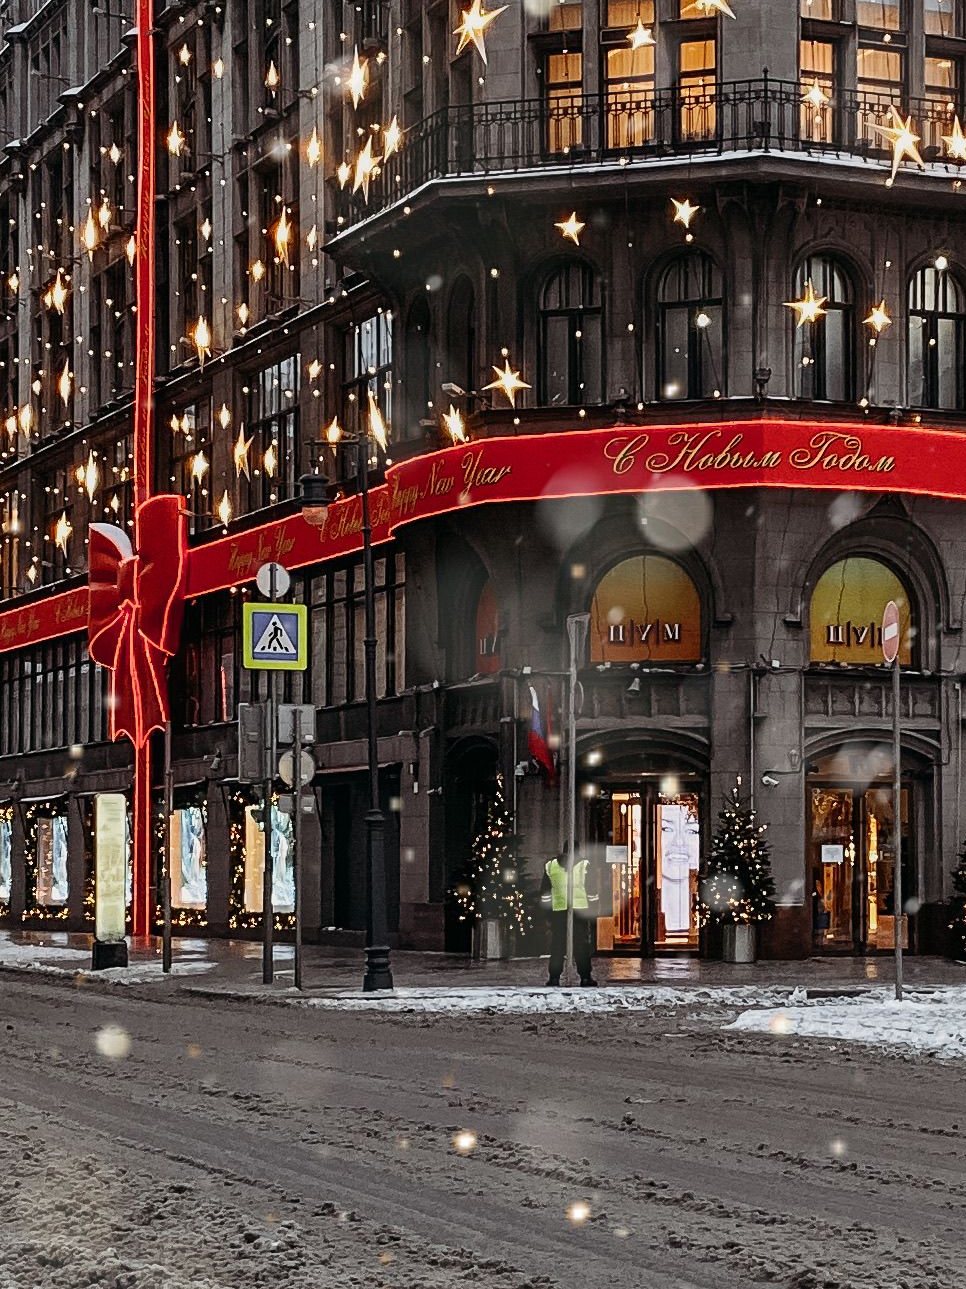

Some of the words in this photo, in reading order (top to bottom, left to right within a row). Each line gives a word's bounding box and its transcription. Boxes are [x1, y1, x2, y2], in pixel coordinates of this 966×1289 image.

[461, 449, 513, 501] Year
[604, 433, 648, 474] С
[646, 430, 782, 473] Новым
[789, 431, 896, 473] Годом
